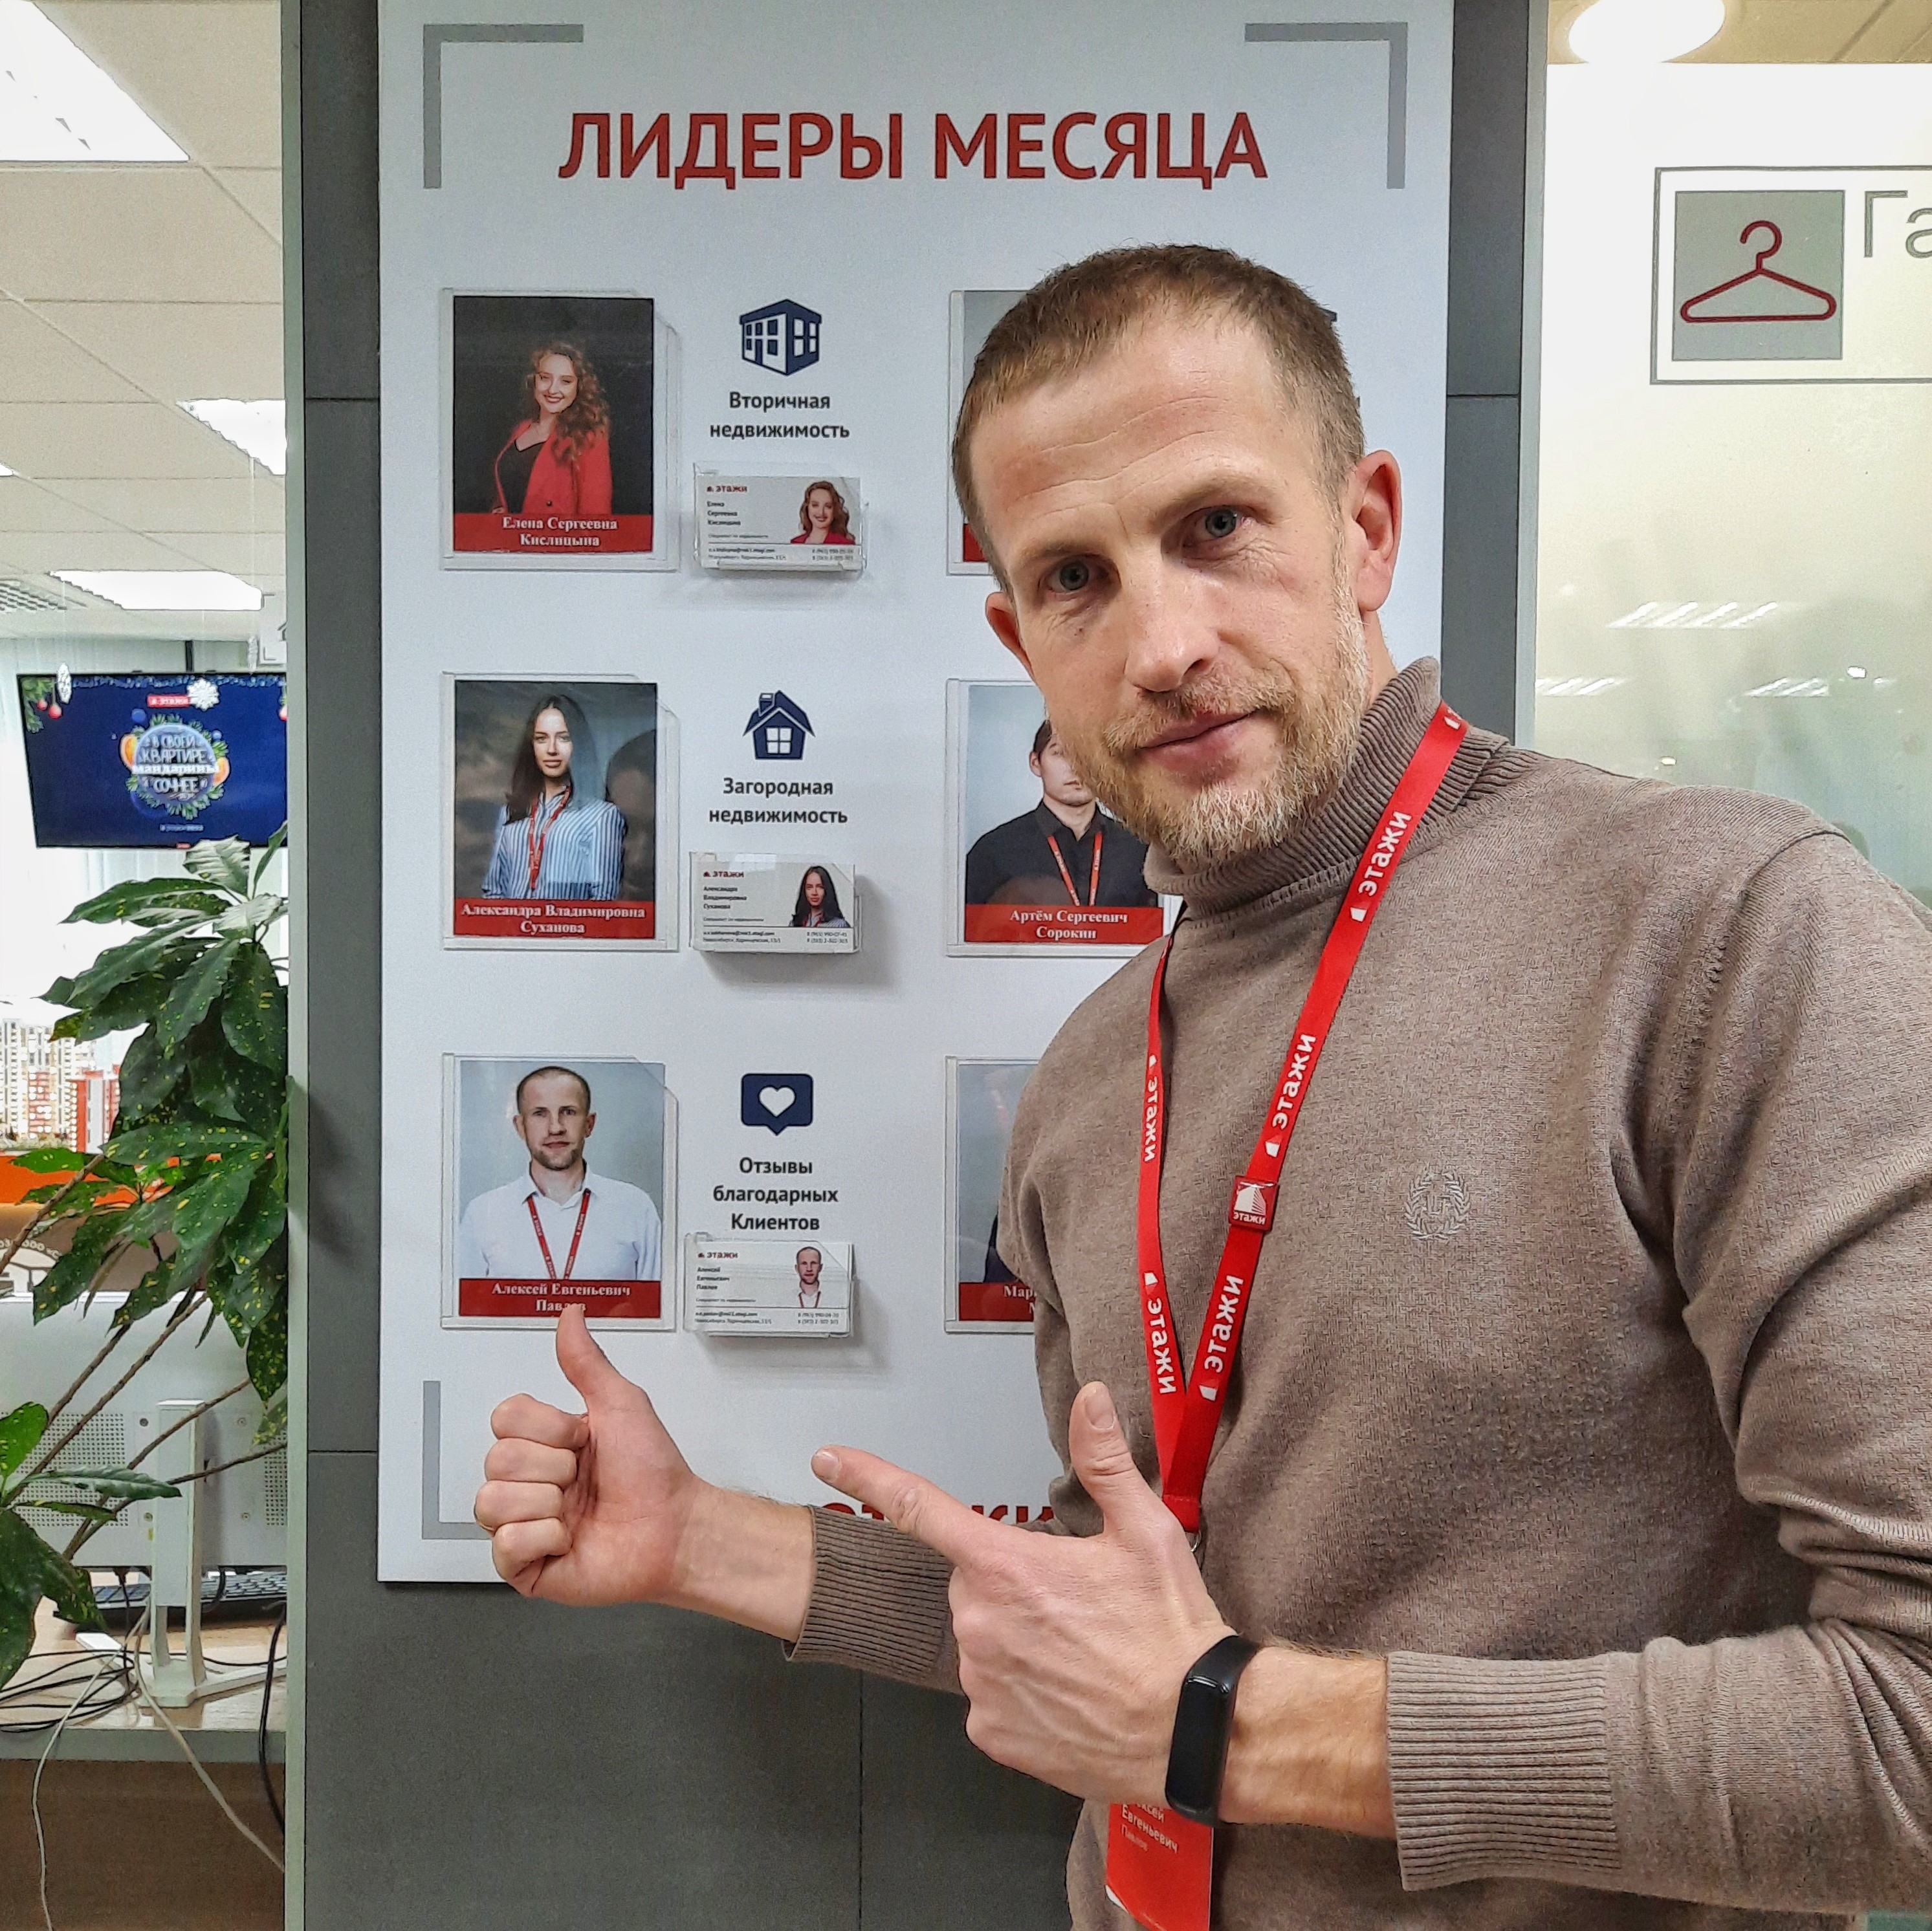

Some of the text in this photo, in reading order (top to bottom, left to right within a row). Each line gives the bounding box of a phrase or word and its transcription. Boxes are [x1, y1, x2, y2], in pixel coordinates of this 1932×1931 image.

[558, 112, 1268, 190] ЛИДЕРЫ МЕСЯЦА
[729, 391, 830, 413] Вторичная
[710, 424, 850, 440] недвижимость
[503, 516, 619, 532] Елена Сергеевна
[520, 533, 600, 547] Кислицына
[142, 748, 208, 764] КВАРТИРЕ
[153, 776, 199, 794] СОЧНЕЕ
[723, 777, 833, 798] Загородная
[709, 809, 848, 825] недвижимость
[1358, 811, 1412, 897] этажи
[461, 903, 646, 921] Александра Владимировна
[1009, 910, 1128, 926] Артём Сергеевич
[520, 921, 586, 935] Суханова
[1036, 926, 1097, 941] Сорокин
[1272, 1034, 1316, 1129] этажи
[1145, 1076, 1158, 1162] этажи
[739, 1157, 813, 1174] Отзывы
[712, 1184, 839, 1206] благодарных
[730, 1213, 820, 1230] Клиентов
[1233, 1212, 1266, 1225] этажи
[491, 1282, 631, 1296] Алексей Евгеньевич
[1205, 1275, 1244, 1373] этажи
[1148, 1298, 1177, 1393] этажи
